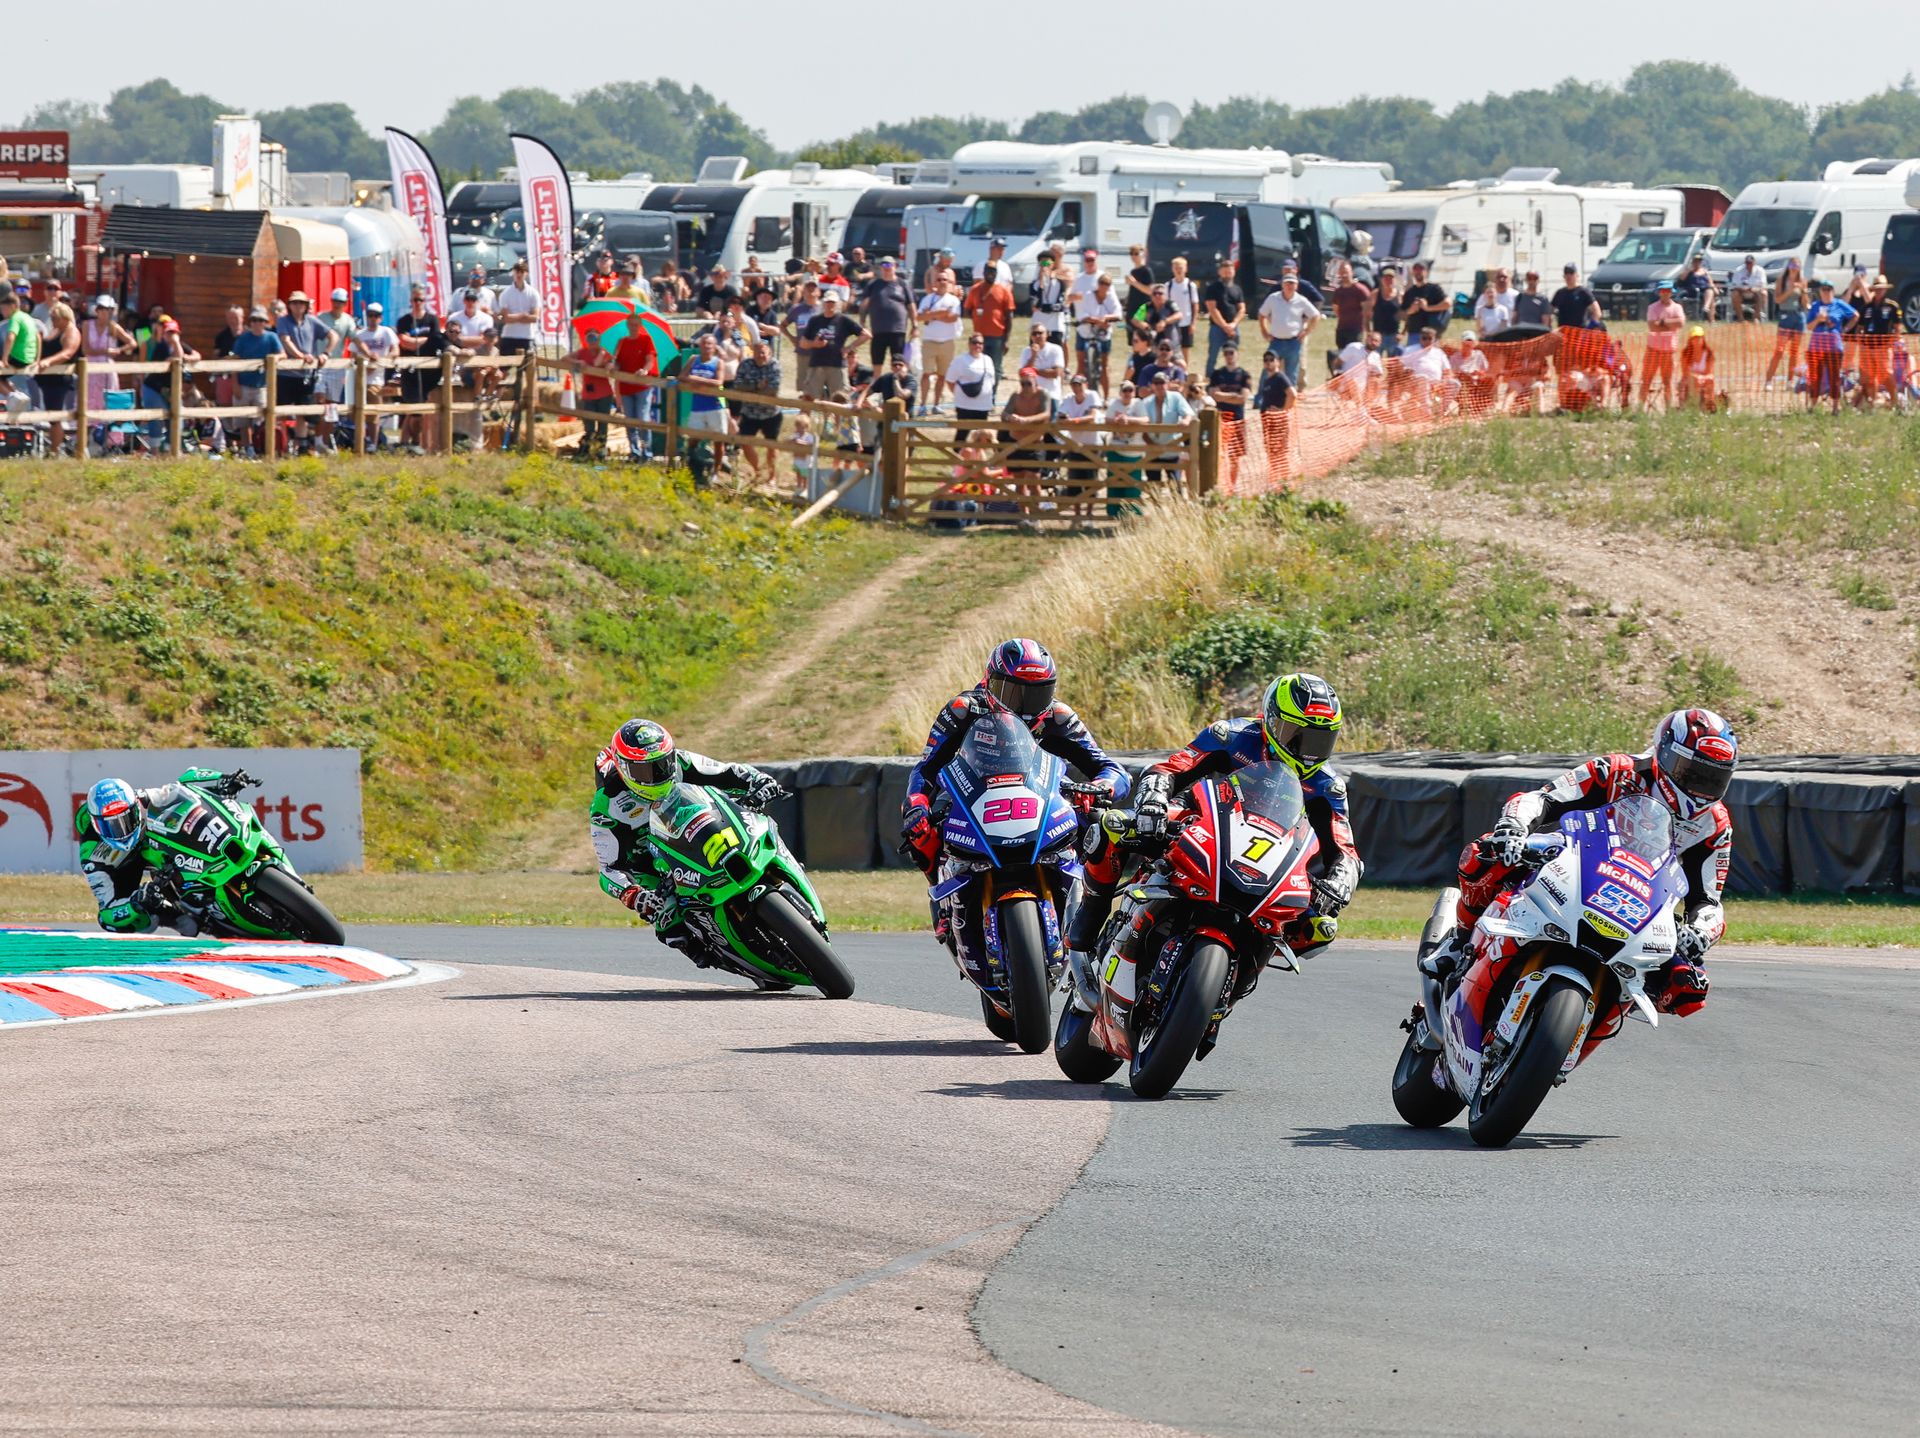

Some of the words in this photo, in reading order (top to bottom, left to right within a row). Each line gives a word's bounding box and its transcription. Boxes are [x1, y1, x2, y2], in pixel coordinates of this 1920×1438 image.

[1, 144, 64, 162] REPES
[983, 797, 1039, 825] 28
[198, 815, 229, 854] 30
[945, 831, 976, 847] YAMAHA
[1047, 818, 1077, 840] YAMAHA
[703, 826, 740, 868] 21
[1241, 836, 1275, 864] 1
[1541, 875, 1568, 903] ashvale
[1597, 863, 1651, 899] McAMS
[1588, 881, 1651, 929] 52
[990, 913, 998, 946] PIRELLI
[1043, 907, 1052, 940] PIRELLI
[1587, 912, 1626, 938] BROSHUIS
[1166, 942, 1183, 974] PIRELLI
[1642, 941, 1672, 949] ashvale
[1105, 955, 1120, 983] 1
